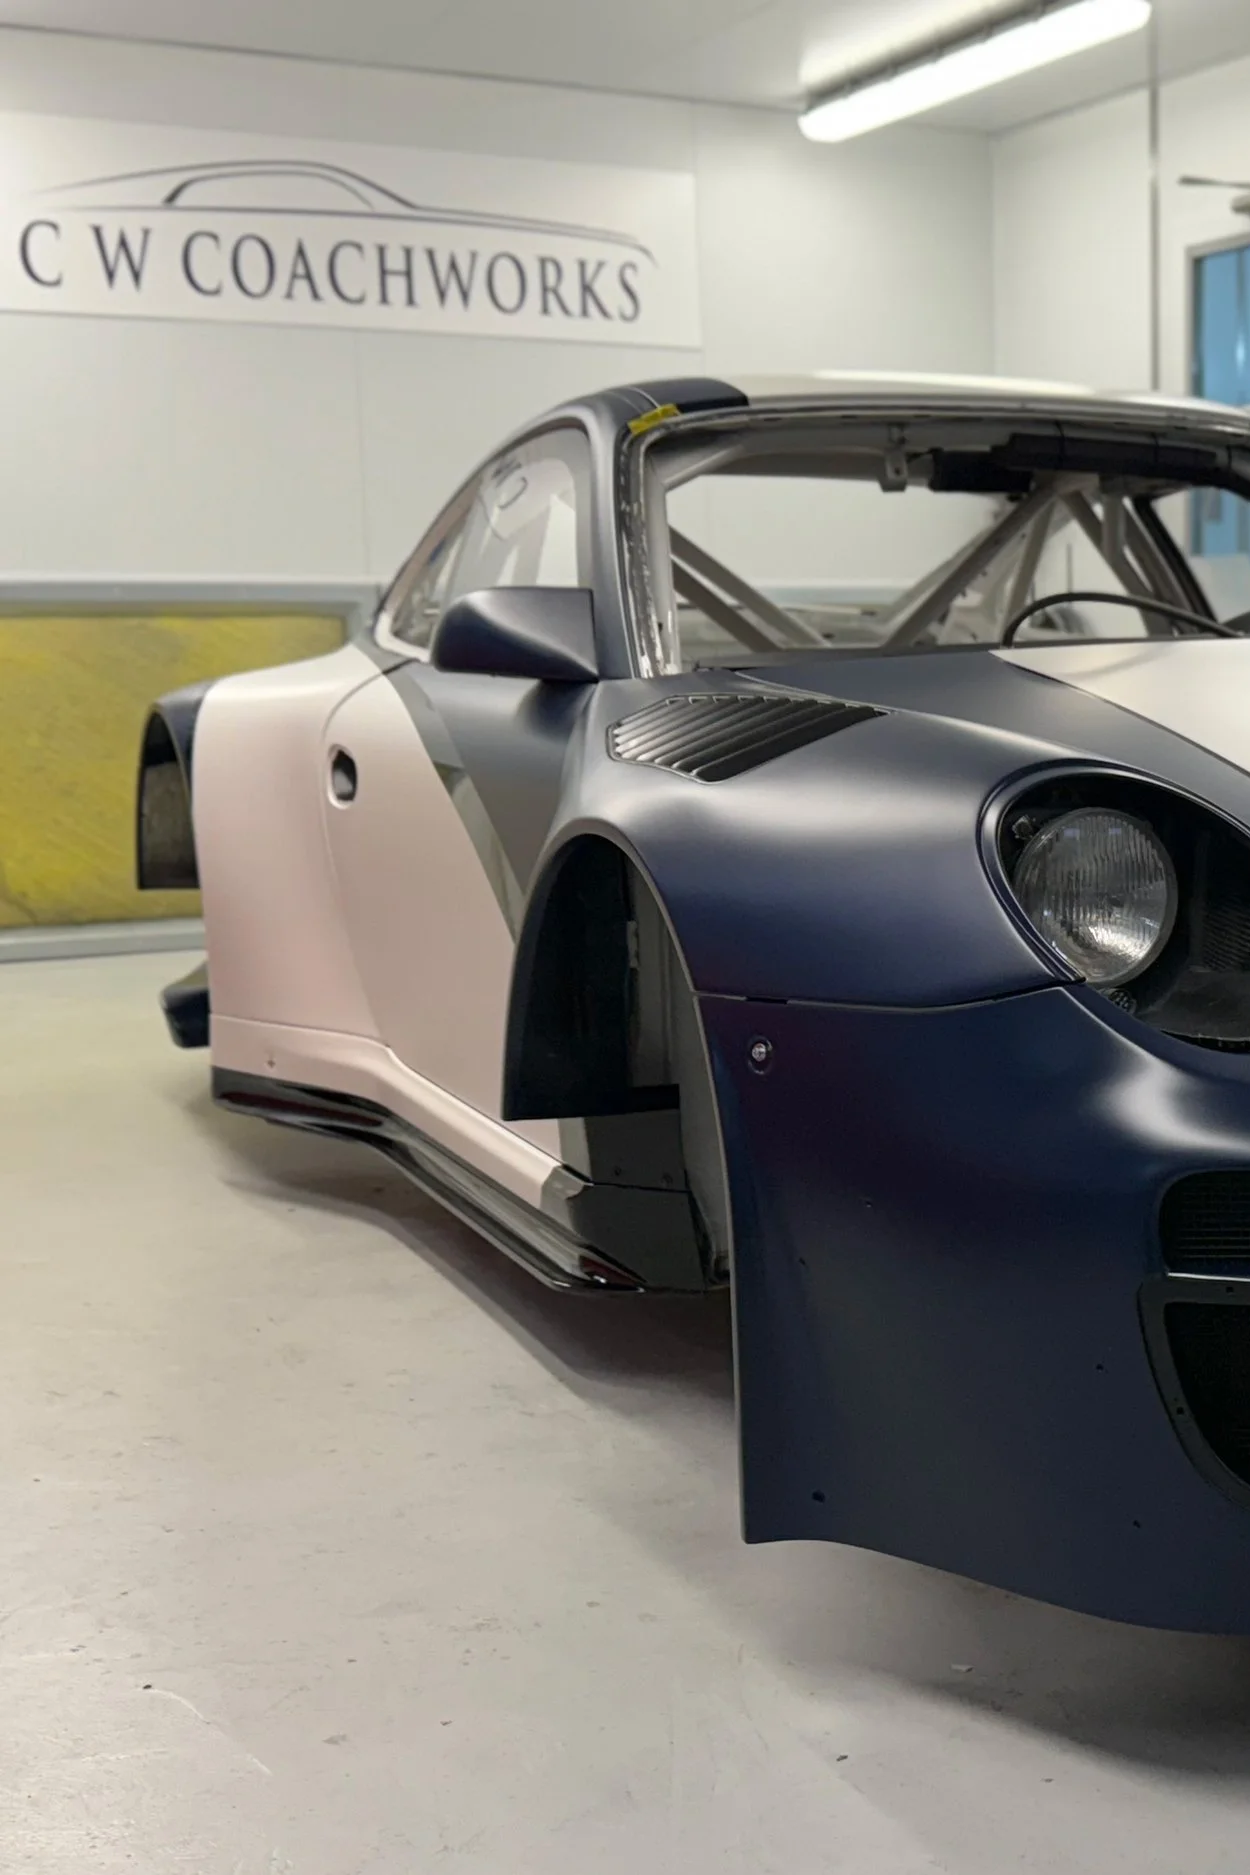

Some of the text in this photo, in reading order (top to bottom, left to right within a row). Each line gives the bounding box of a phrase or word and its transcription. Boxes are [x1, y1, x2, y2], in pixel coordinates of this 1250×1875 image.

[19, 220, 641, 323] C W COACHWORKS
